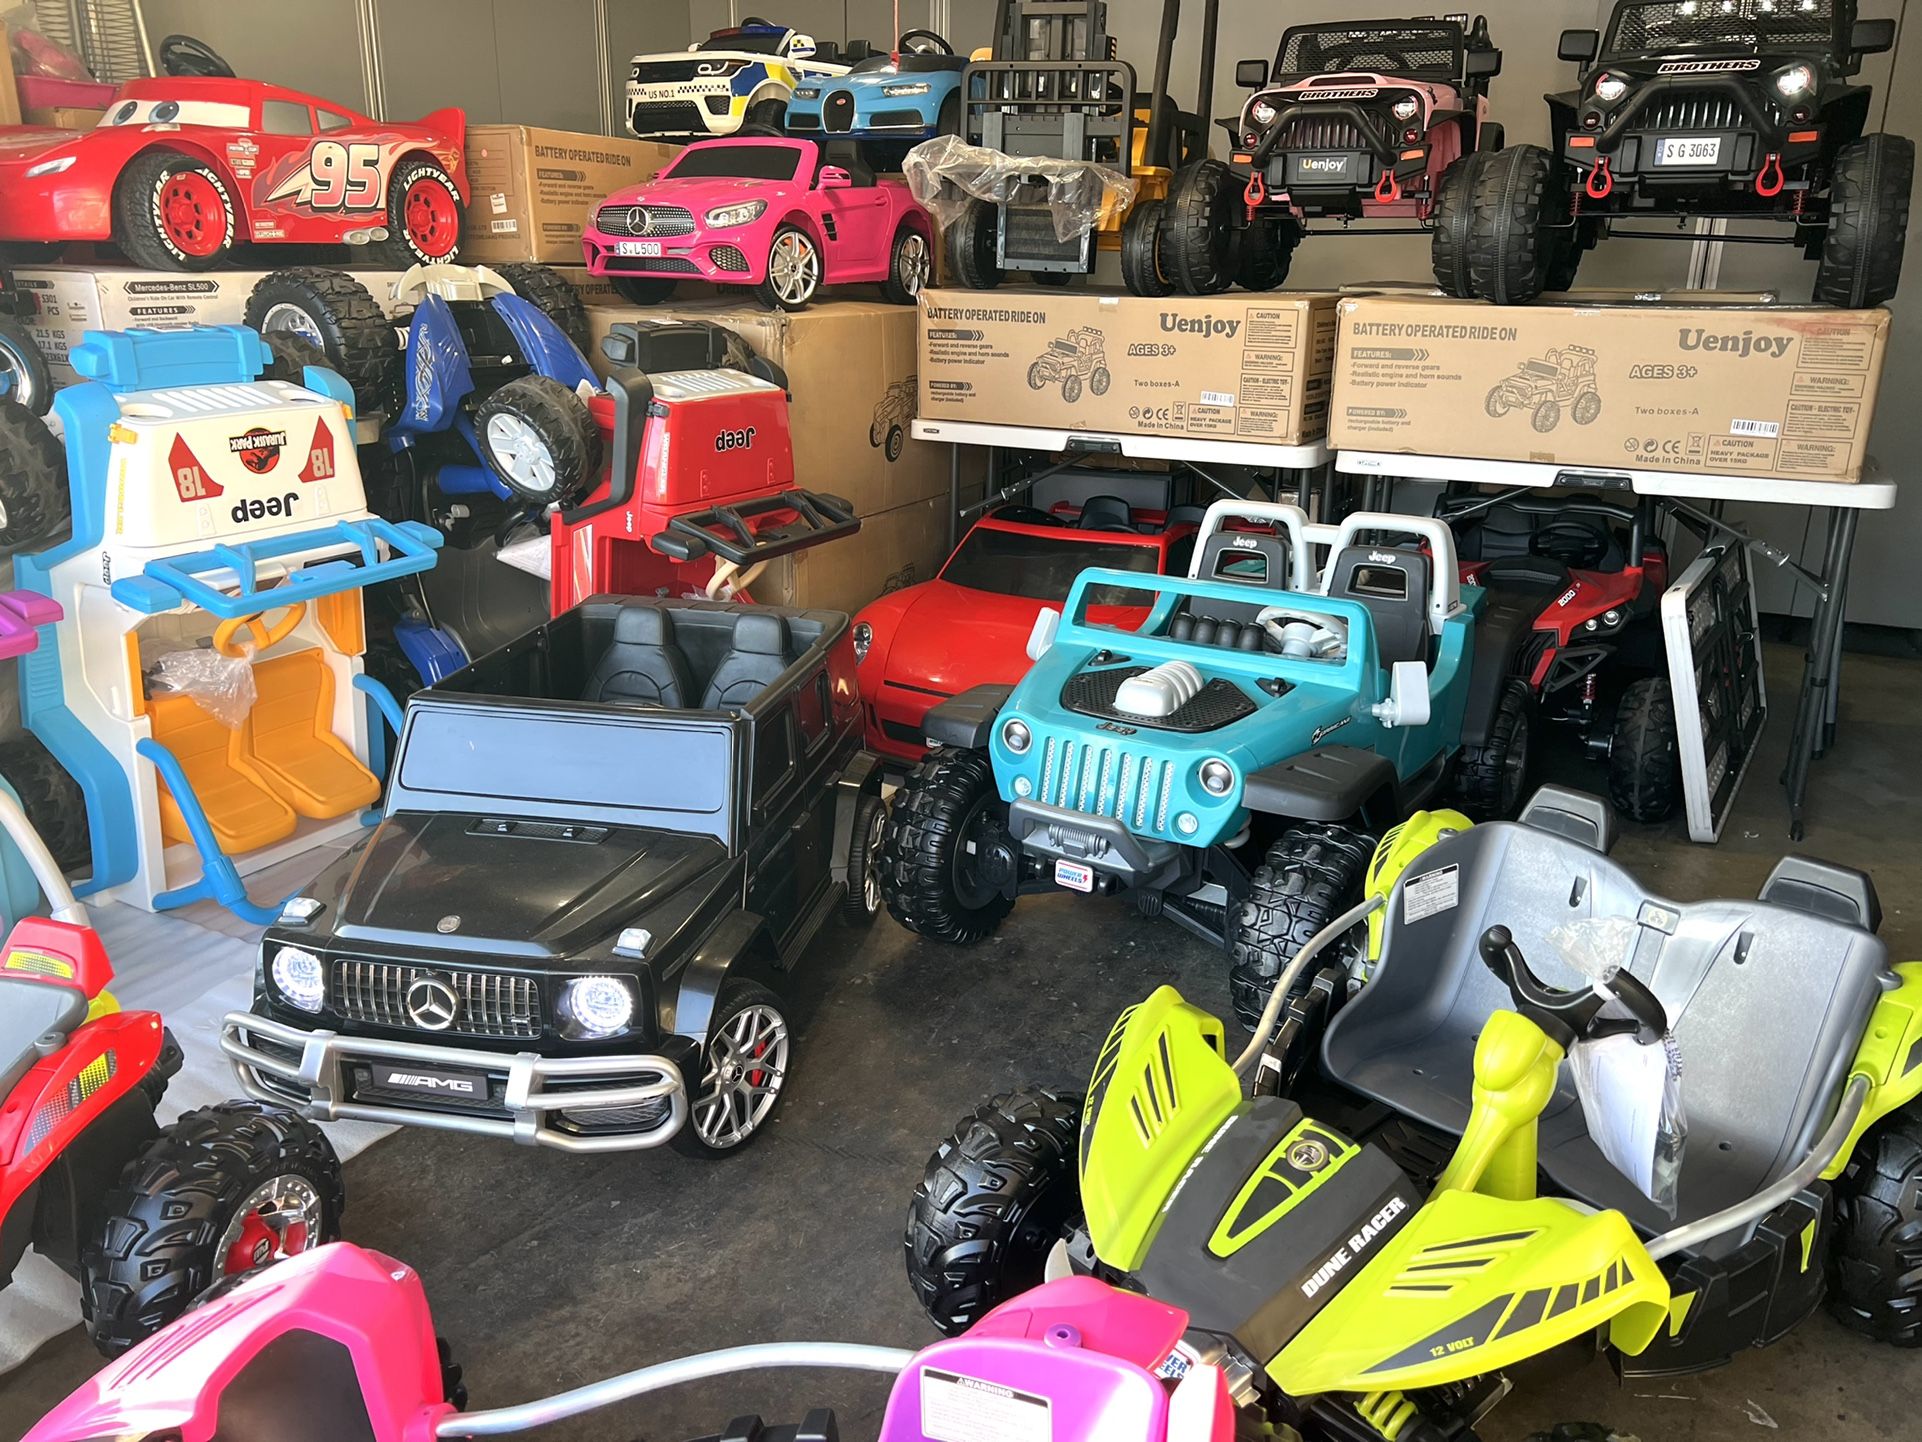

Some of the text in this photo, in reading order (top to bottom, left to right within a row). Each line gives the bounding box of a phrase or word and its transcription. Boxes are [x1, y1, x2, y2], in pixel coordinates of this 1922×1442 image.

[1658, 60, 1760, 73] BROTHERS
[648, 90, 675, 99] US NO.1
[1299, 89, 1378, 100] BROTHERS
[535, 145, 631, 166] BATTERY OPERATED RIDE ON
[1667, 144, 1716, 158] S G 3063
[1303, 158, 1345, 172] Uenjoy
[311, 141, 381, 211] 95
[403, 167, 460, 202] LIGHTYEAR
[194, 168, 235, 249] LIGHTYEAR
[134, 282, 208, 292] Mercedes-Benz SL500
[928, 307, 1046, 324] BATTERY OPERATED RIDE ON
[1256, 312, 1280, 320] CAUTION
[1160, 313, 1241, 338] Uenjoy
[1353, 323, 1518, 341] BATTERY OPERATED RIDE ON
[36, 329, 66, 338] 21.5 KGS
[54, 342, 68, 350] KGS
[1679, 328, 1794, 358] Uenjoy
[1128, 344, 1176, 356] AGES 3+
[1354, 350, 1392, 358] FEATURES:
[1254, 354, 1282, 362] WARNING:
[1629, 364, 1698, 379] AGES 3+
[1150, 380, 1180, 388] boxes-A
[1810, 376, 1850, 384] WARNING:
[1634, 406, 1699, 416] Two boxes-A
[1791, 404, 1813, 412] CAUTION
[1138, 420, 1156, 428] Made
[1164, 422, 1184, 430] China
[230, 436, 254, 450] PARK
[715, 426, 756, 452] Jeep
[1722, 440, 1754, 448] CAUTION
[1797, 444, 1836, 452] WARNING:
[311, 448, 334, 477] 18
[1635, 454, 1660, 463] Made
[1673, 456, 1700, 465] China
[177, 466, 206, 498] 18
[231, 492, 300, 523] Jeep
[626, 511, 634, 532] Jeep
[1232, 536, 1258, 548] Jeep
[1368, 551, 1396, 564] Jeep
[1057, 872, 1082, 884] WHEELS
[1059, 868, 1082, 876] POWER
[415, 1076, 473, 1092] AMG
[1301, 1197, 1406, 1298] DUNE RACER
[1430, 1336, 1474, 1357] 12 VOLT
[965, 1379, 1014, 1398] WARNING
